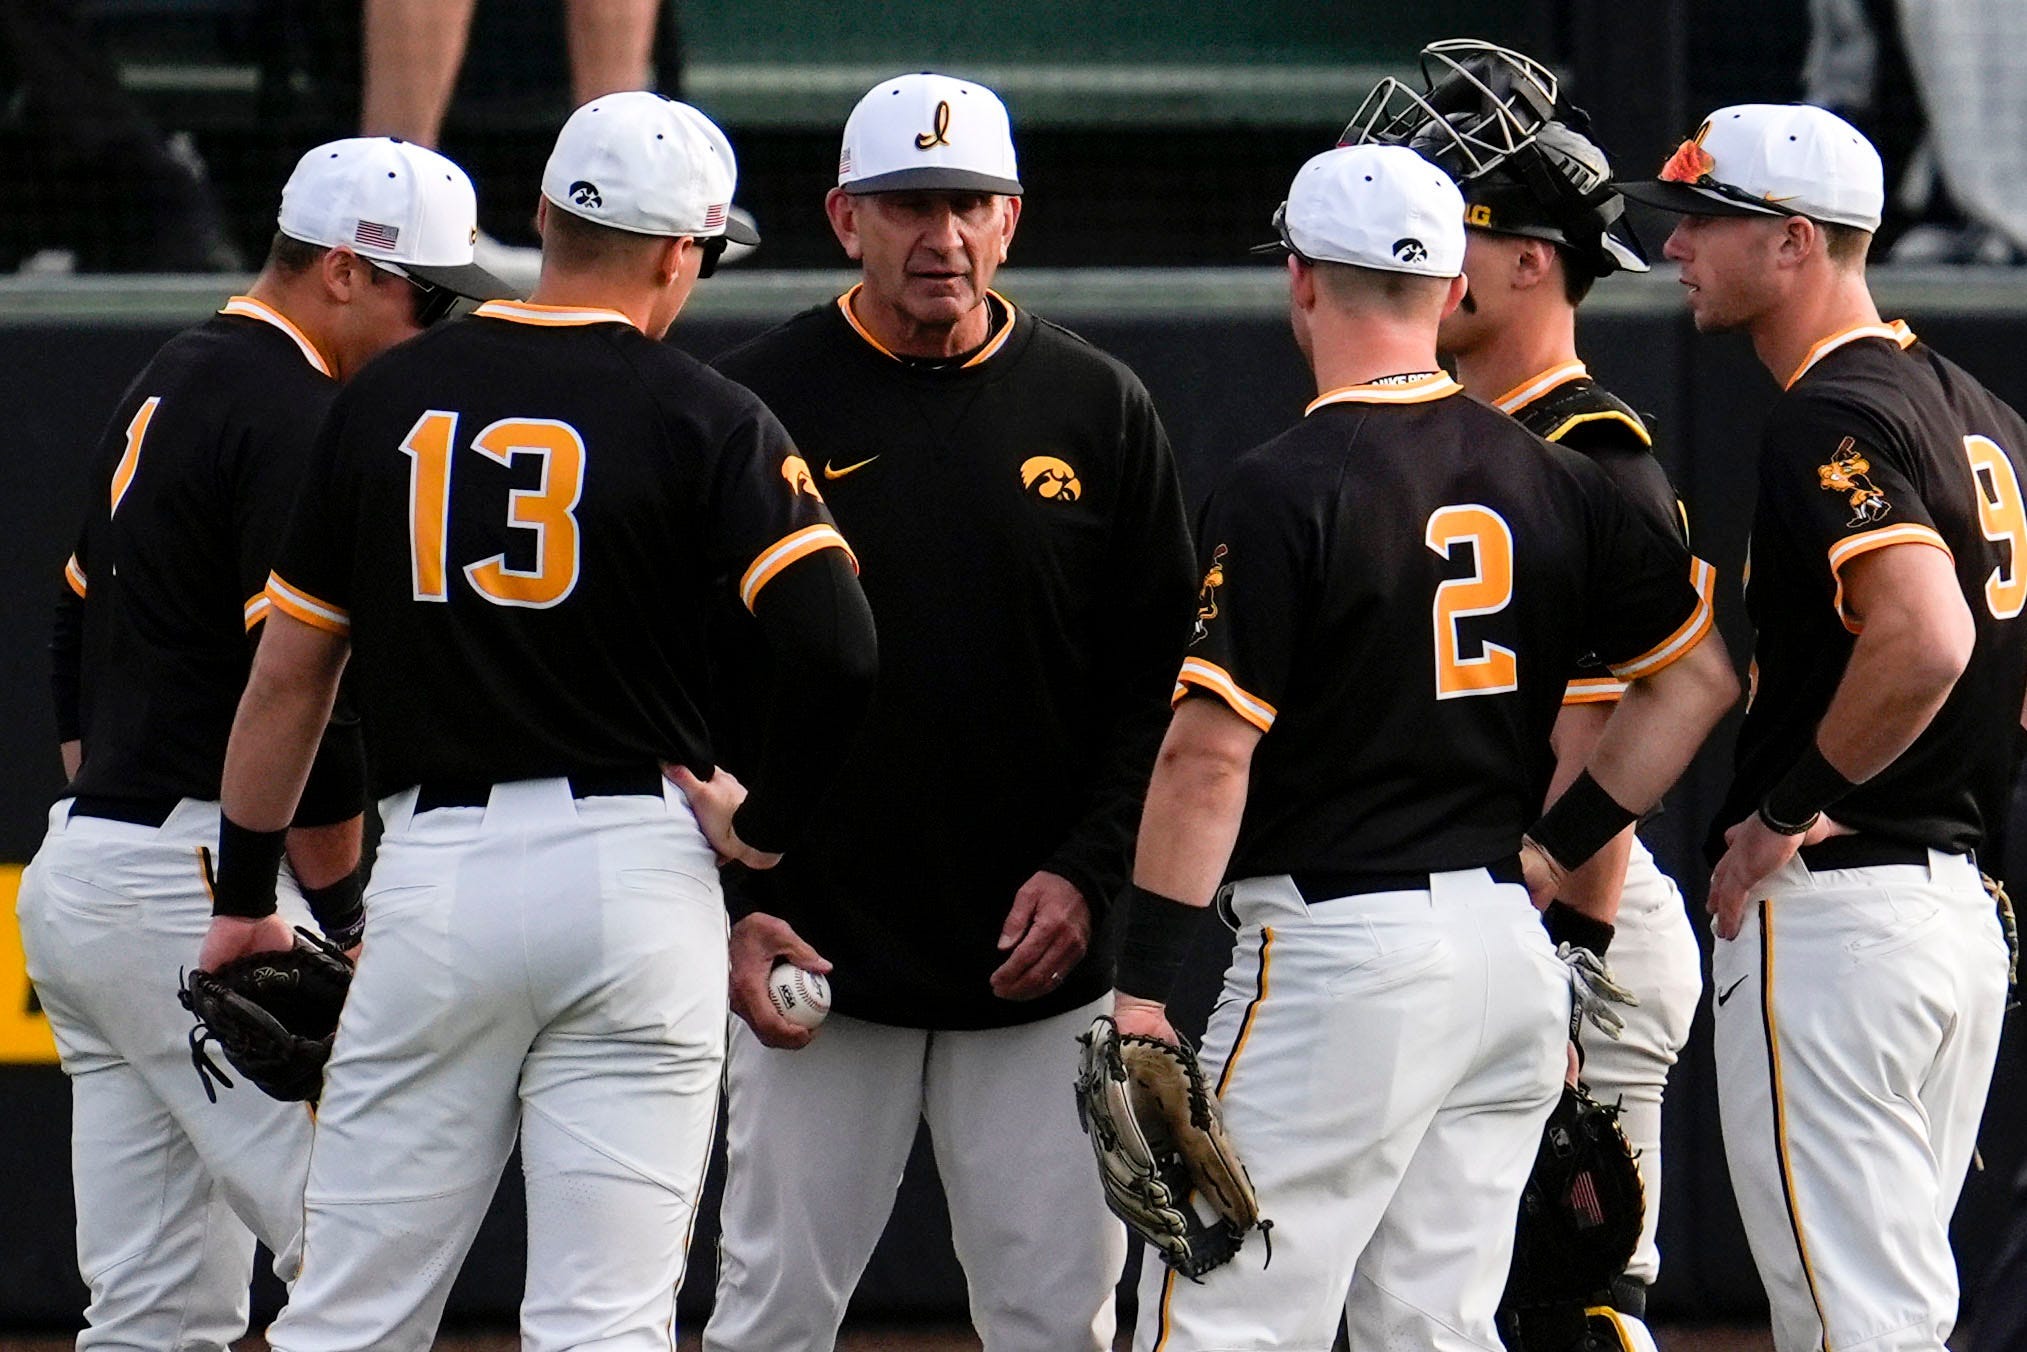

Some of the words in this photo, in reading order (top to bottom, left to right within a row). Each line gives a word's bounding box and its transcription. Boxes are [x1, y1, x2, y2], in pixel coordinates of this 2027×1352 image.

[398, 409, 587, 611] 13
[1425, 503, 1519, 702] 2
[1963, 434, 2027, 621] 9
